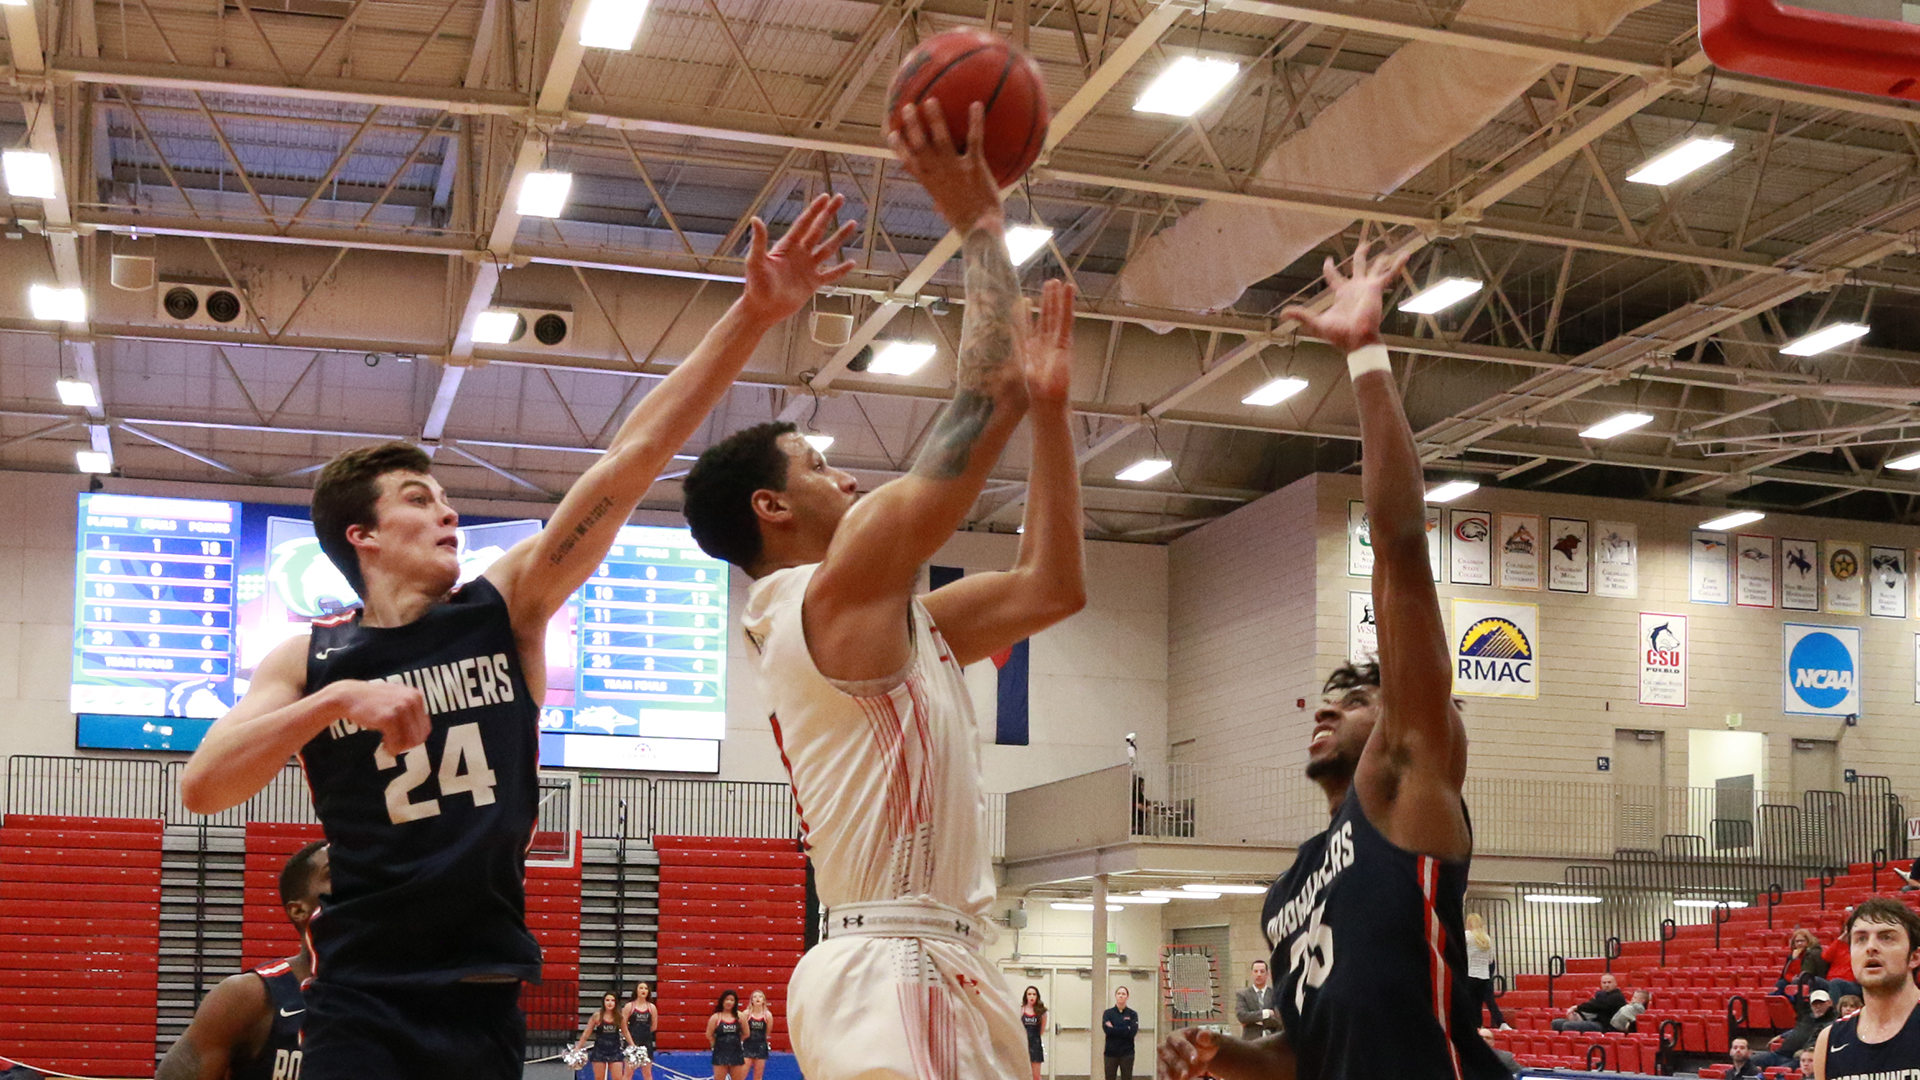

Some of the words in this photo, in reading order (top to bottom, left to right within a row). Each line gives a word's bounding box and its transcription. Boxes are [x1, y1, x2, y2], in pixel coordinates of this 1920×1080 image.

[101, 536, 110, 550] 1
[153, 539, 161, 552] 1
[98, 560, 111, 573] 4
[151, 586, 160, 599] 1
[93, 607, 112, 621] 11
[594, 608, 611, 622] 11
[646, 611, 654, 625] 1
[91, 631, 113, 645] 24
[148, 633, 160, 647] 2
[592, 632, 610, 645] 21
[645, 634, 653, 647] 1
[105, 657, 136, 668] TEAM
[137, 658, 174, 670] FOULS
[200, 659, 213, 673] 4
[592, 655, 612, 668] 24
[644, 657, 655, 671] 2
[1647, 649, 1680, 666] CSU
[1458, 659, 1531, 683] RMAC
[603, 679, 633, 690] TEAM
[634, 680, 668, 692] FOULS
[693, 681, 704, 695] 7
[1795, 668, 1852, 692] NCAA
[374, 722, 497, 825] 24
